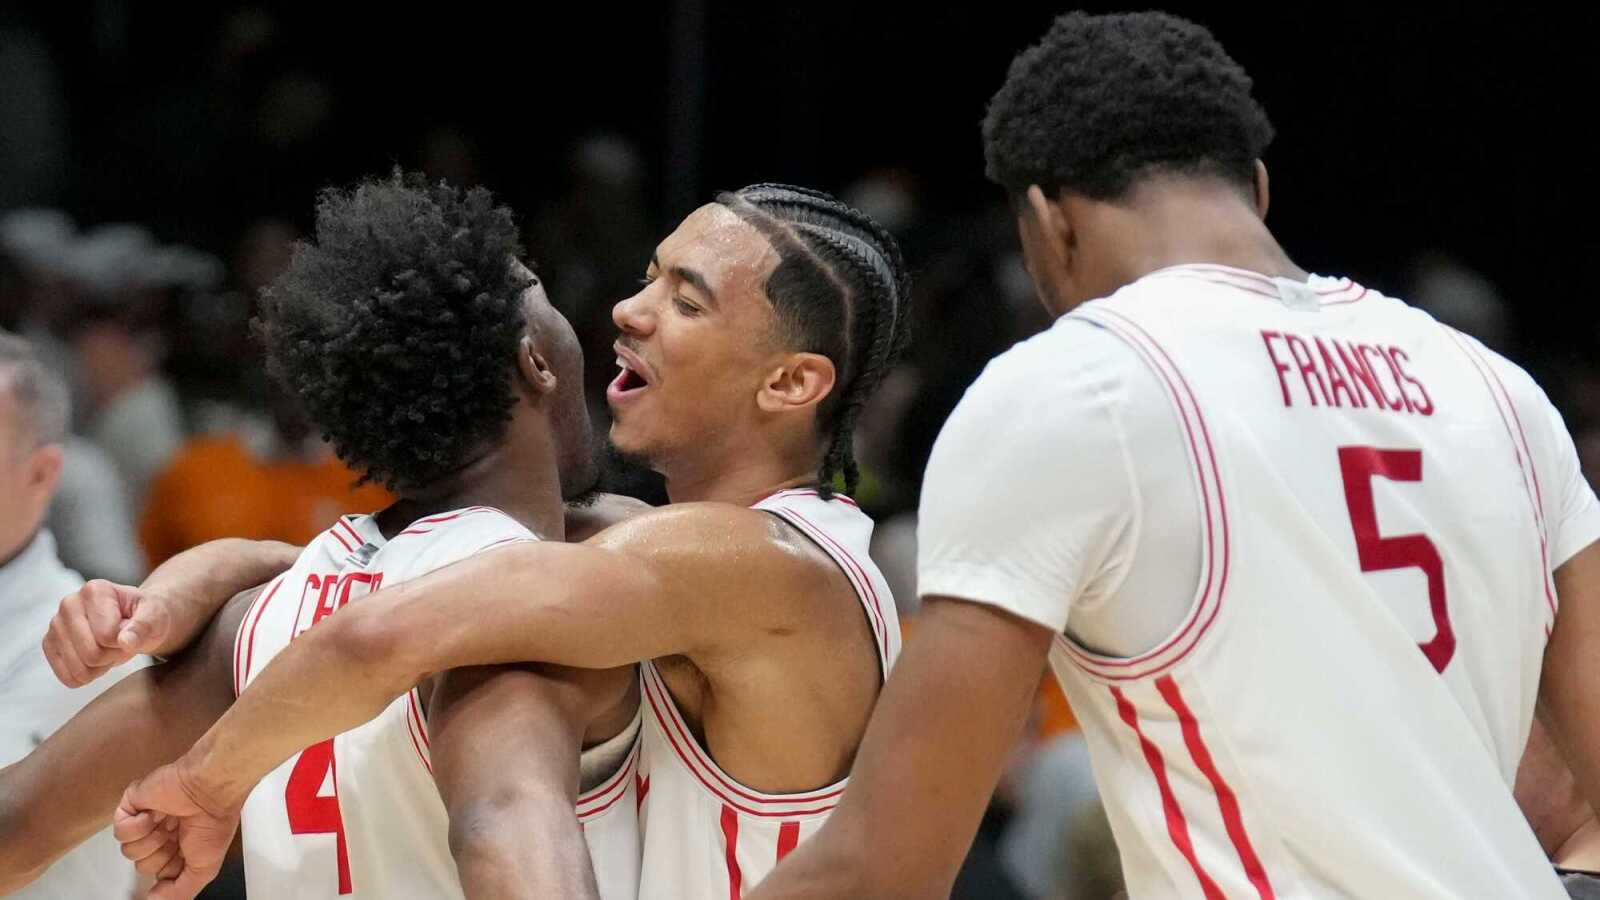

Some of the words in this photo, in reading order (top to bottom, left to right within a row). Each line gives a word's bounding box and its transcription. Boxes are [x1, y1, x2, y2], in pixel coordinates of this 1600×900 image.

[1260, 329, 1435, 416] FRANCIS
[1337, 445, 1456, 674] 5
[284, 736, 353, 896] 4
